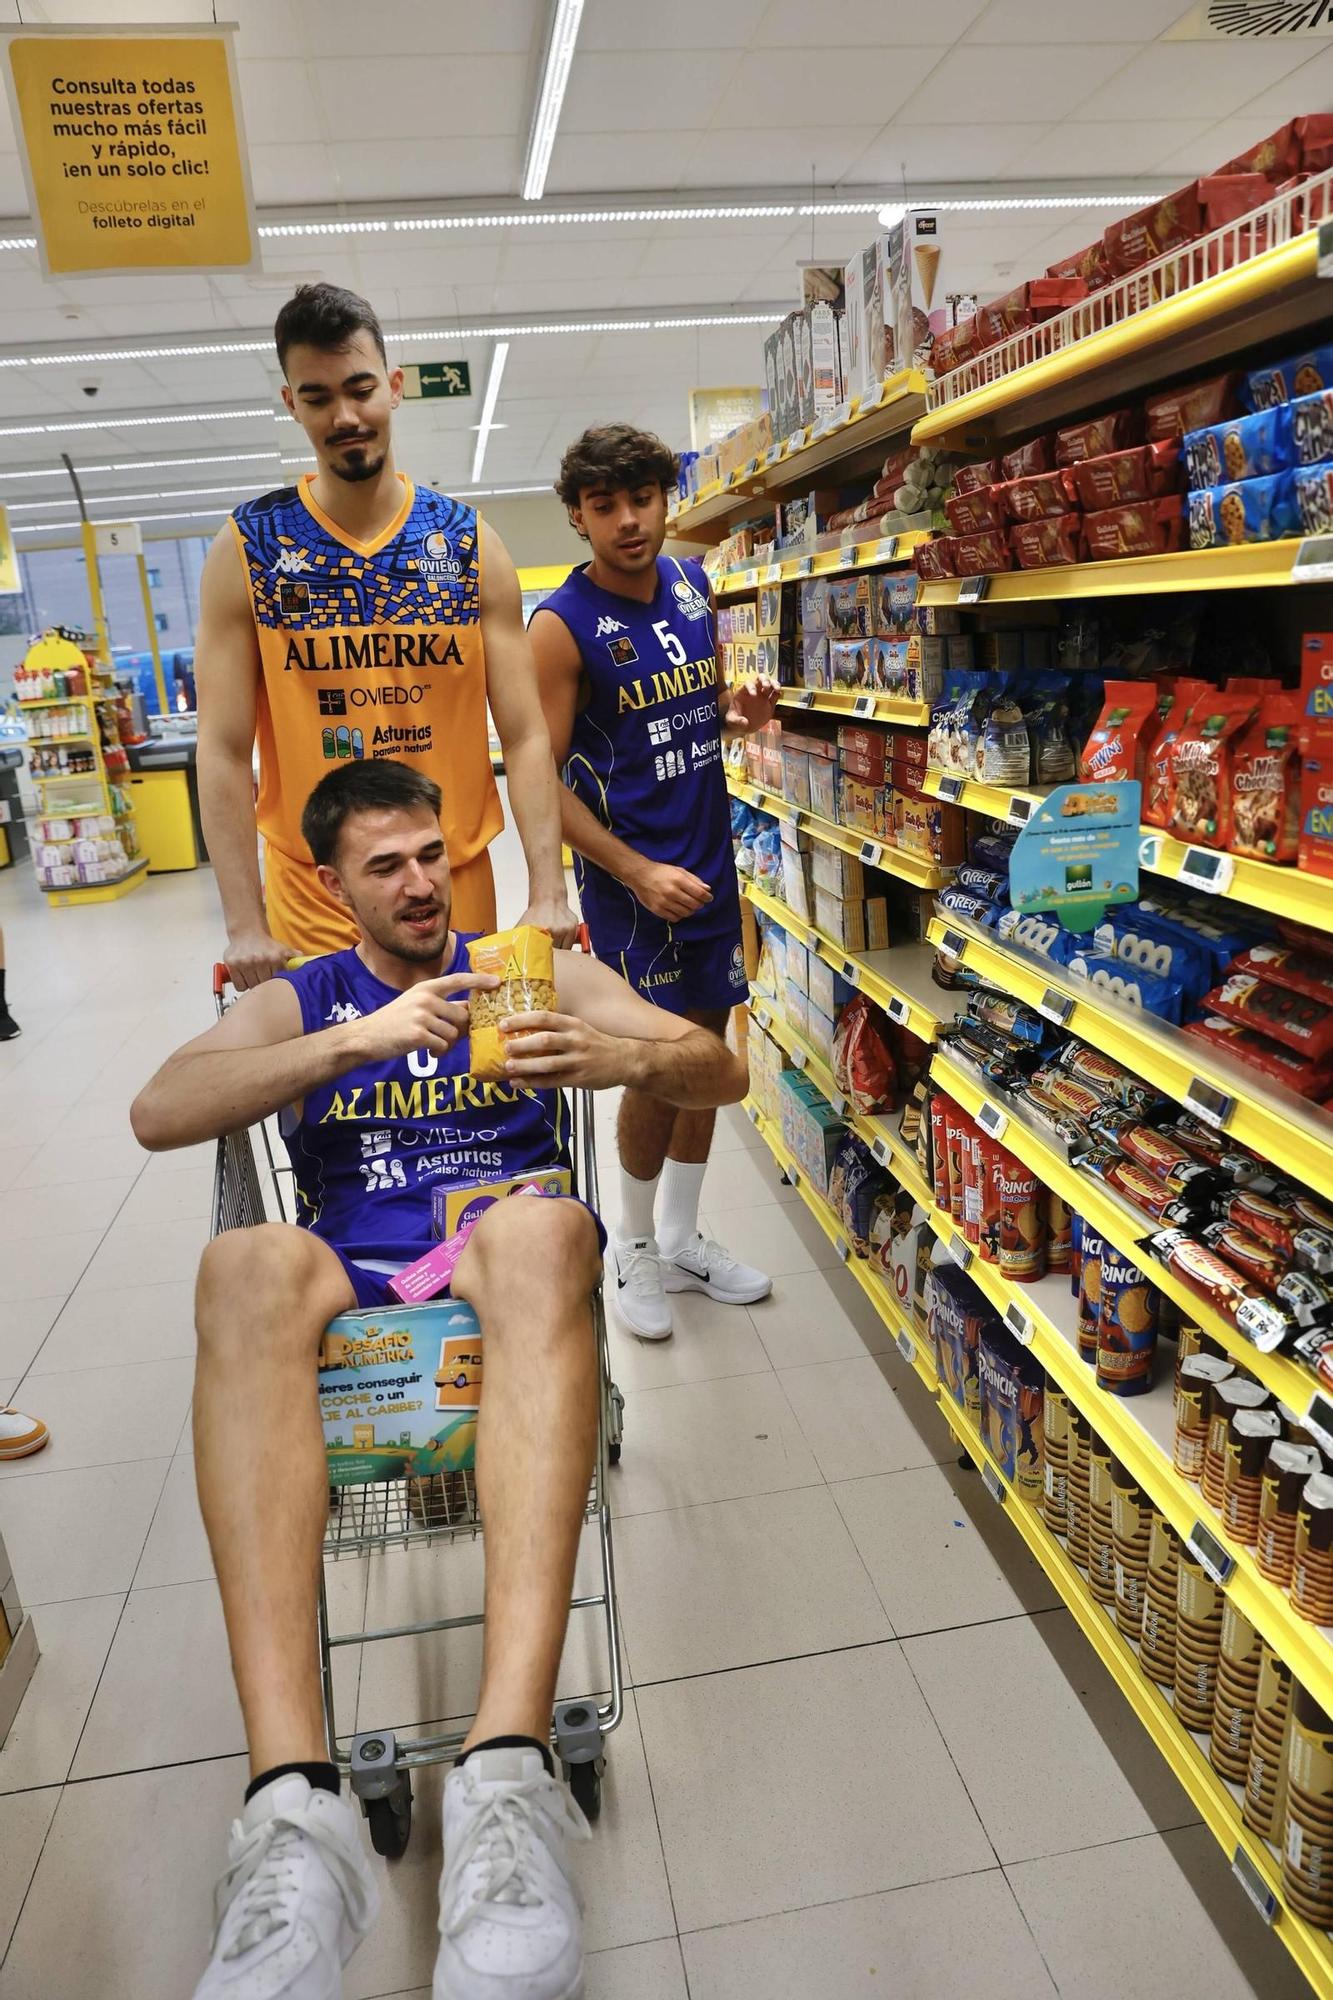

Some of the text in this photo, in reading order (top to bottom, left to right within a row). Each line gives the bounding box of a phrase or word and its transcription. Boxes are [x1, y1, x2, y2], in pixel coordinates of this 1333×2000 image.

[52, 78, 196, 94] Consulta todas
[50, 99, 203, 116] nuestras ofertas
[53, 118, 208, 137] mucho más fácil
[92, 140, 176, 159] y rápido,
[98, 163, 120, 177] un
[127, 161, 166, 177] solo
[172, 160, 210, 176] clic!
[78, 198, 206, 215] Descúbrelas en el
[93, 213, 196, 230] folleto digital
[110, 532, 119, 546] 5
[420, 558, 462, 574] OVIEDO
[651, 619, 687, 666] 5
[284, 633, 464, 671] ALIMERKA
[372, 725, 432, 745] Asturias
[404, 741, 432, 754] natural
[960, 869, 992, 886] OREO
[945, 893, 978, 911] OREO
[505, 953, 523, 980] A
[416, 1149, 502, 1172] Asturias
[634, 1242, 647, 1250] NIKE
[931, 1292, 965, 1336] PRINCIPE
[357, 1371, 423, 1390] conseguir
[978, 1351, 1019, 1406] PRINCIPE
[321, 1391, 405, 1408] COCHE o un
[325, 1401, 423, 1421] JE AL CARIBE?
